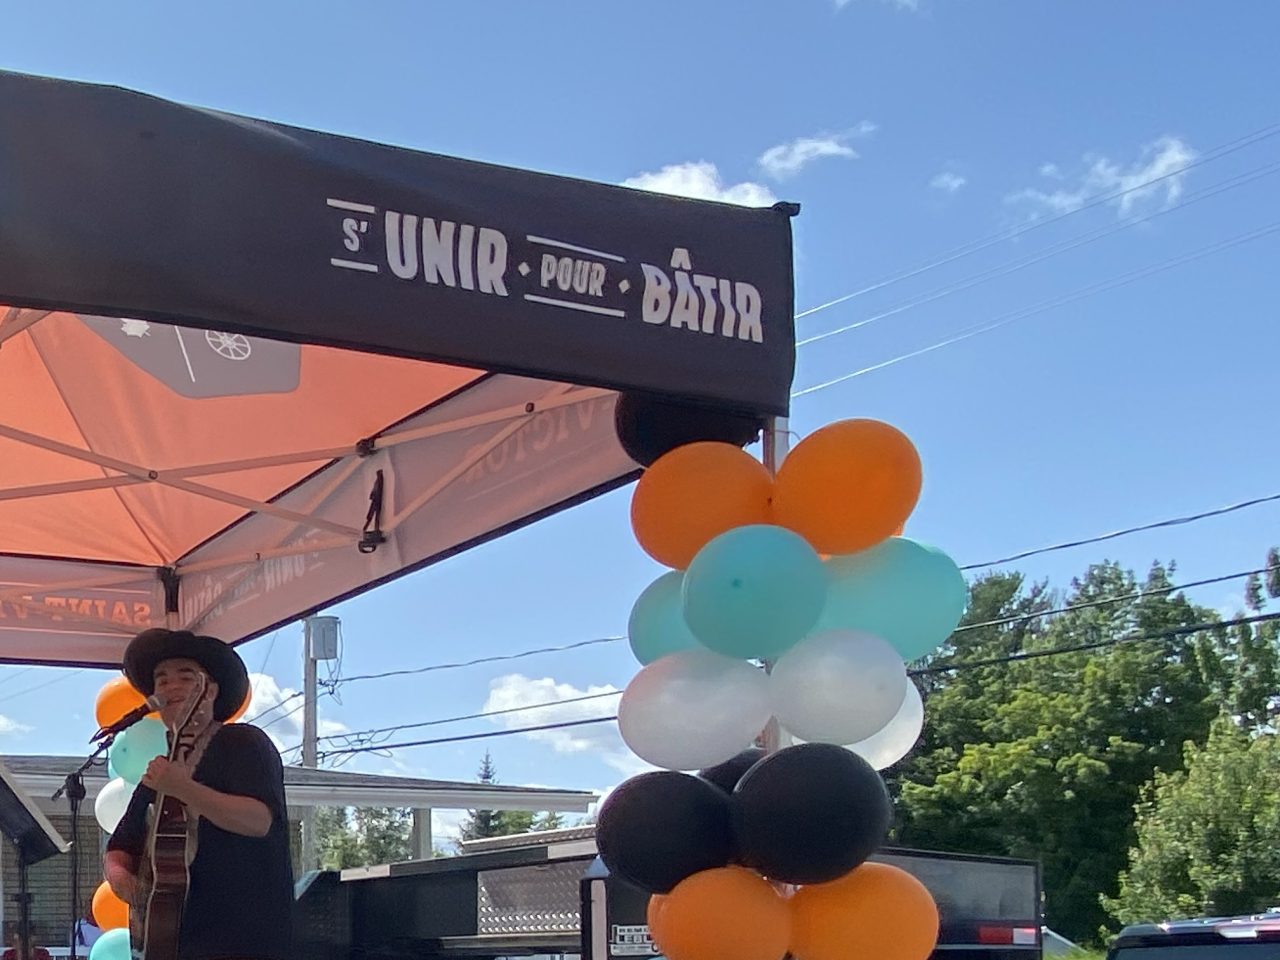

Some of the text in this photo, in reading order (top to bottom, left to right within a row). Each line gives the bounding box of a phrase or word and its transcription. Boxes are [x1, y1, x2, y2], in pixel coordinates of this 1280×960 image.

[384, 210, 509, 297] UNIR
[540, 253, 605, 297] POUR
[640, 247, 764, 344] BÂTIR
